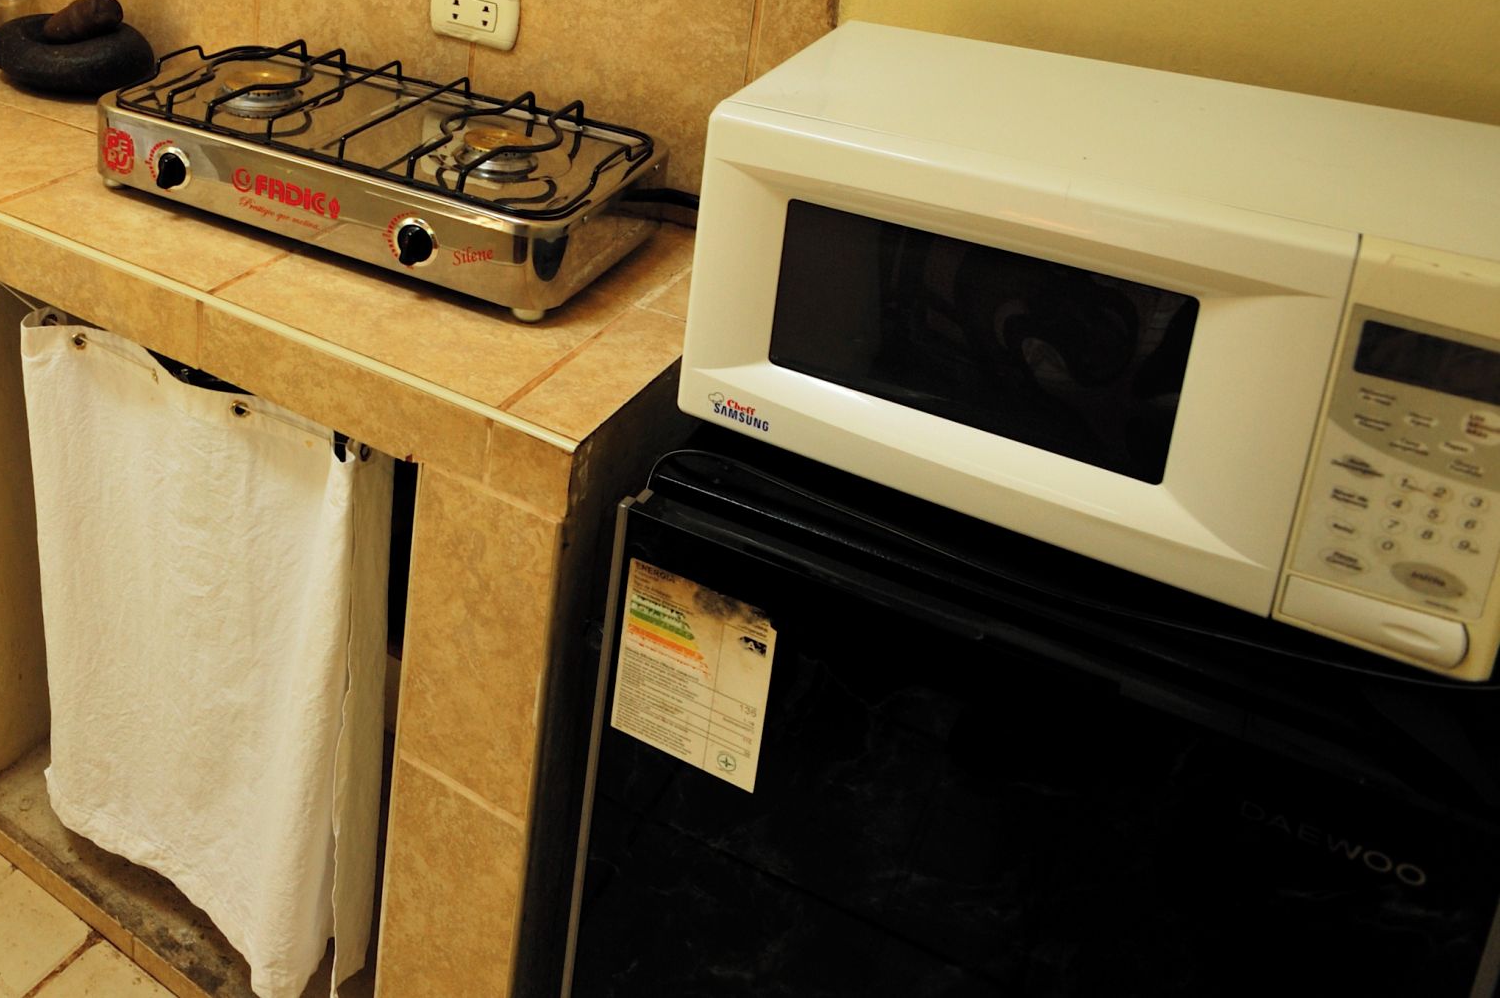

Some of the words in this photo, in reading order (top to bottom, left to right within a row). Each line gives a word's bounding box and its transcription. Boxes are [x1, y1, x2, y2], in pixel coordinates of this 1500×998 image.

[255, 174, 326, 216] FADIC
[713, 402, 770, 432] SAMSUNG
[726, 399, 756, 415] Cheff
[1241, 800, 1426, 886] DAEWOO
